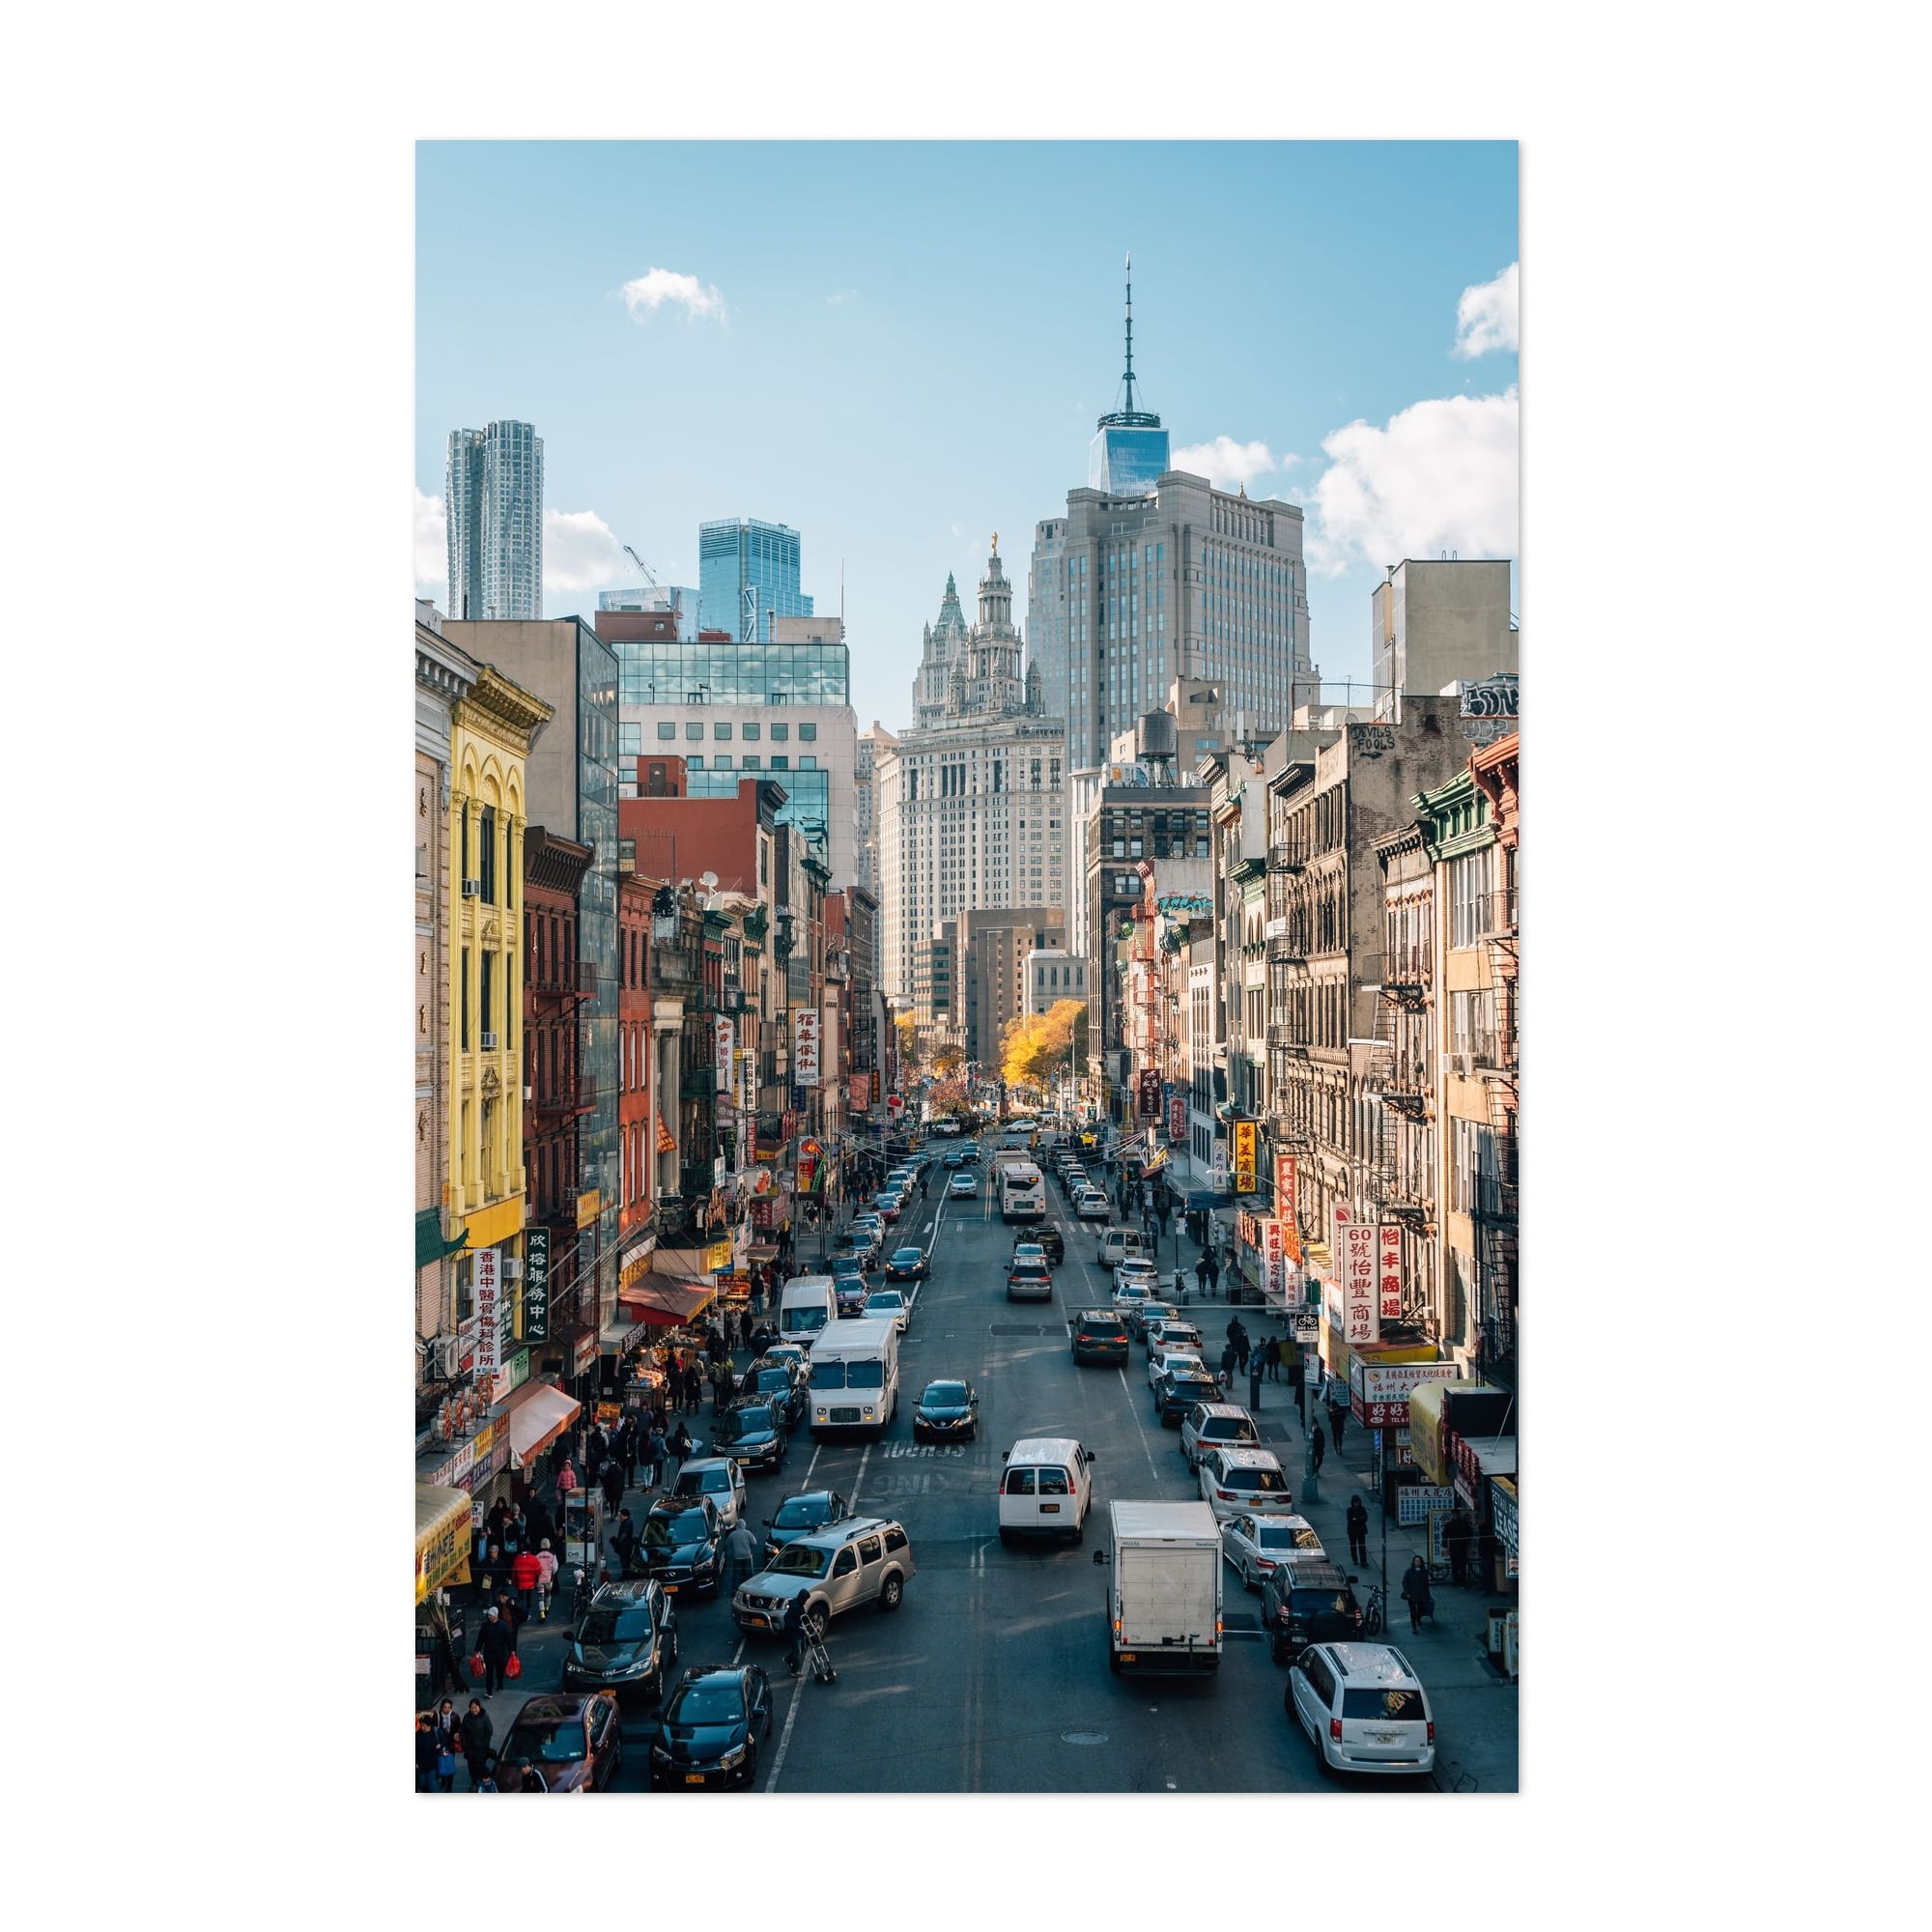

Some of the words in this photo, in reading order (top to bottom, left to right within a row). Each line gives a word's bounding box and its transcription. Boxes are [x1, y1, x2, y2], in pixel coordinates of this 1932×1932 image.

[1357, 738, 1395, 751] FOOLS
[1238, 1124, 1254, 1190] 華美商場
[478, 1251, 496, 1366] 香港中醫骨傷科診所
[528, 1235, 547, 1335] 欣榕服務中心
[1399, 1487, 1453, 1498] 福州大花店
